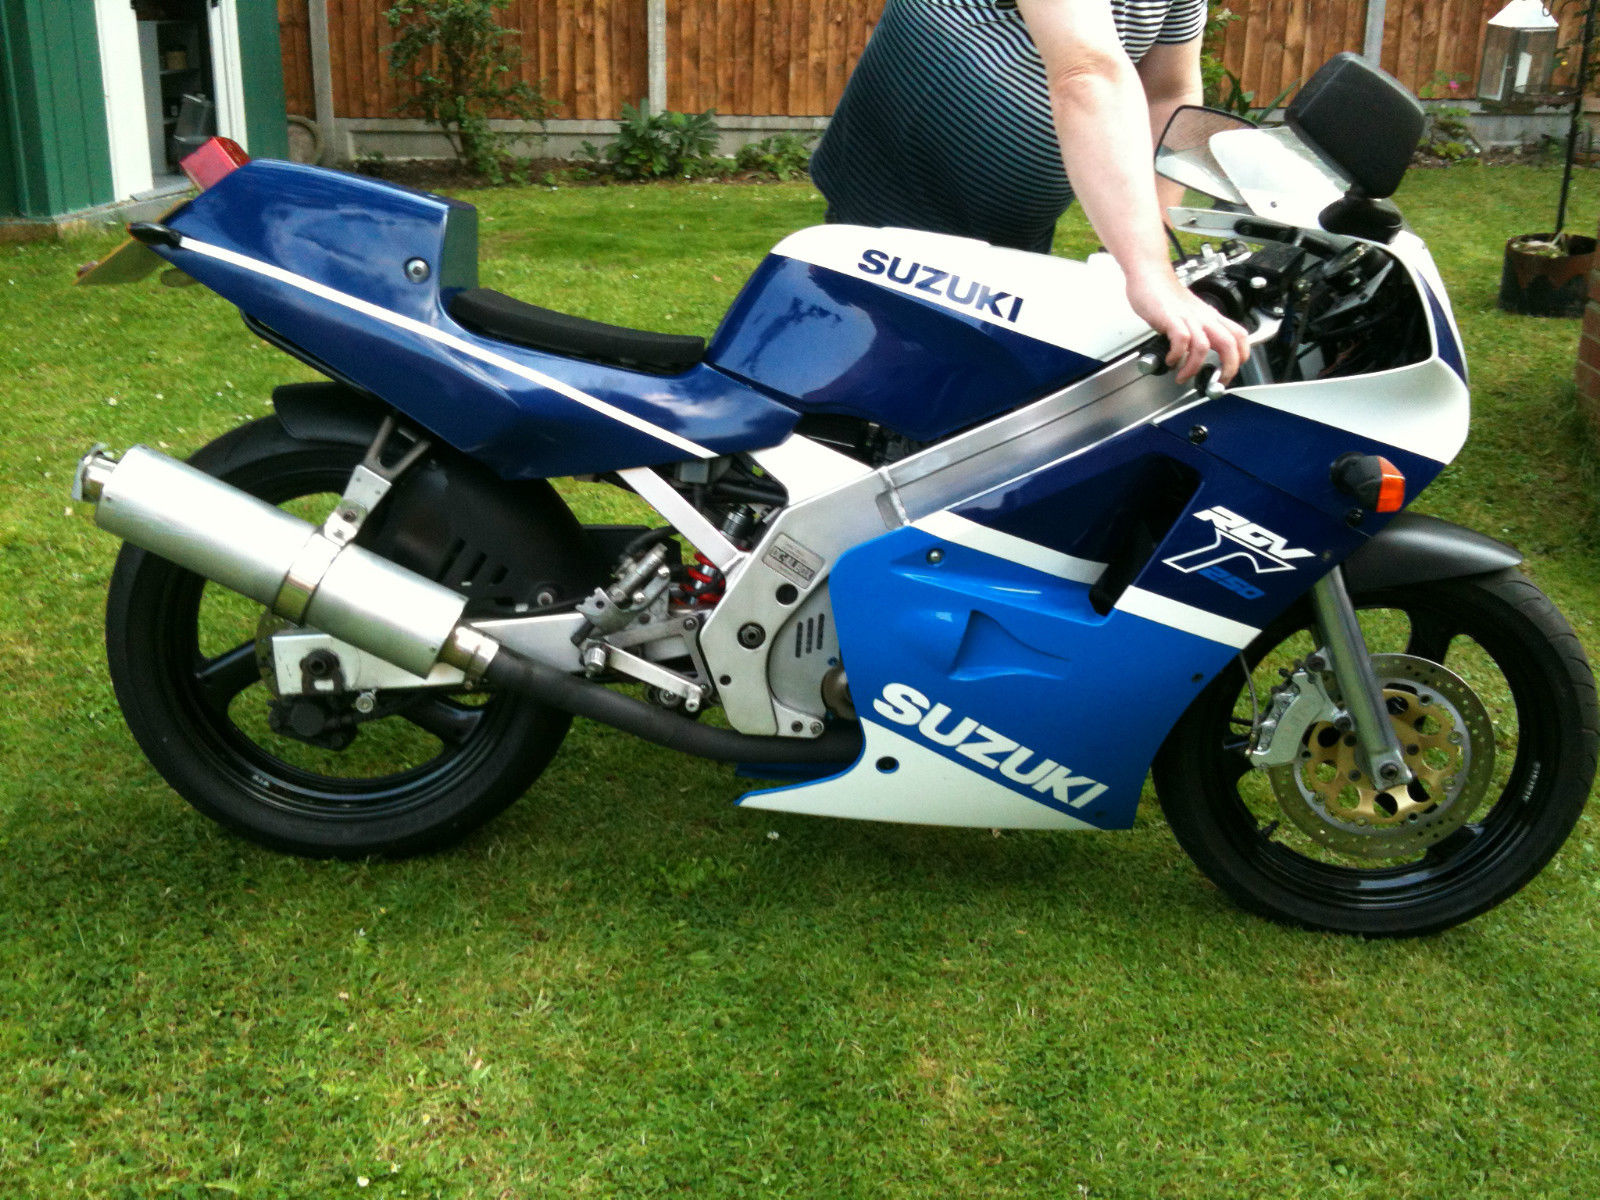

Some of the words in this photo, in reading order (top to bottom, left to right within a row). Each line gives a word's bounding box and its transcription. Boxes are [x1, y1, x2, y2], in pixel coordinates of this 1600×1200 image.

[857, 249, 1024, 323] SUZUKI
[1192, 505, 1316, 560] RGV
[1197, 566, 1265, 600] 250
[872, 682, 1110, 809] SUZUKI
